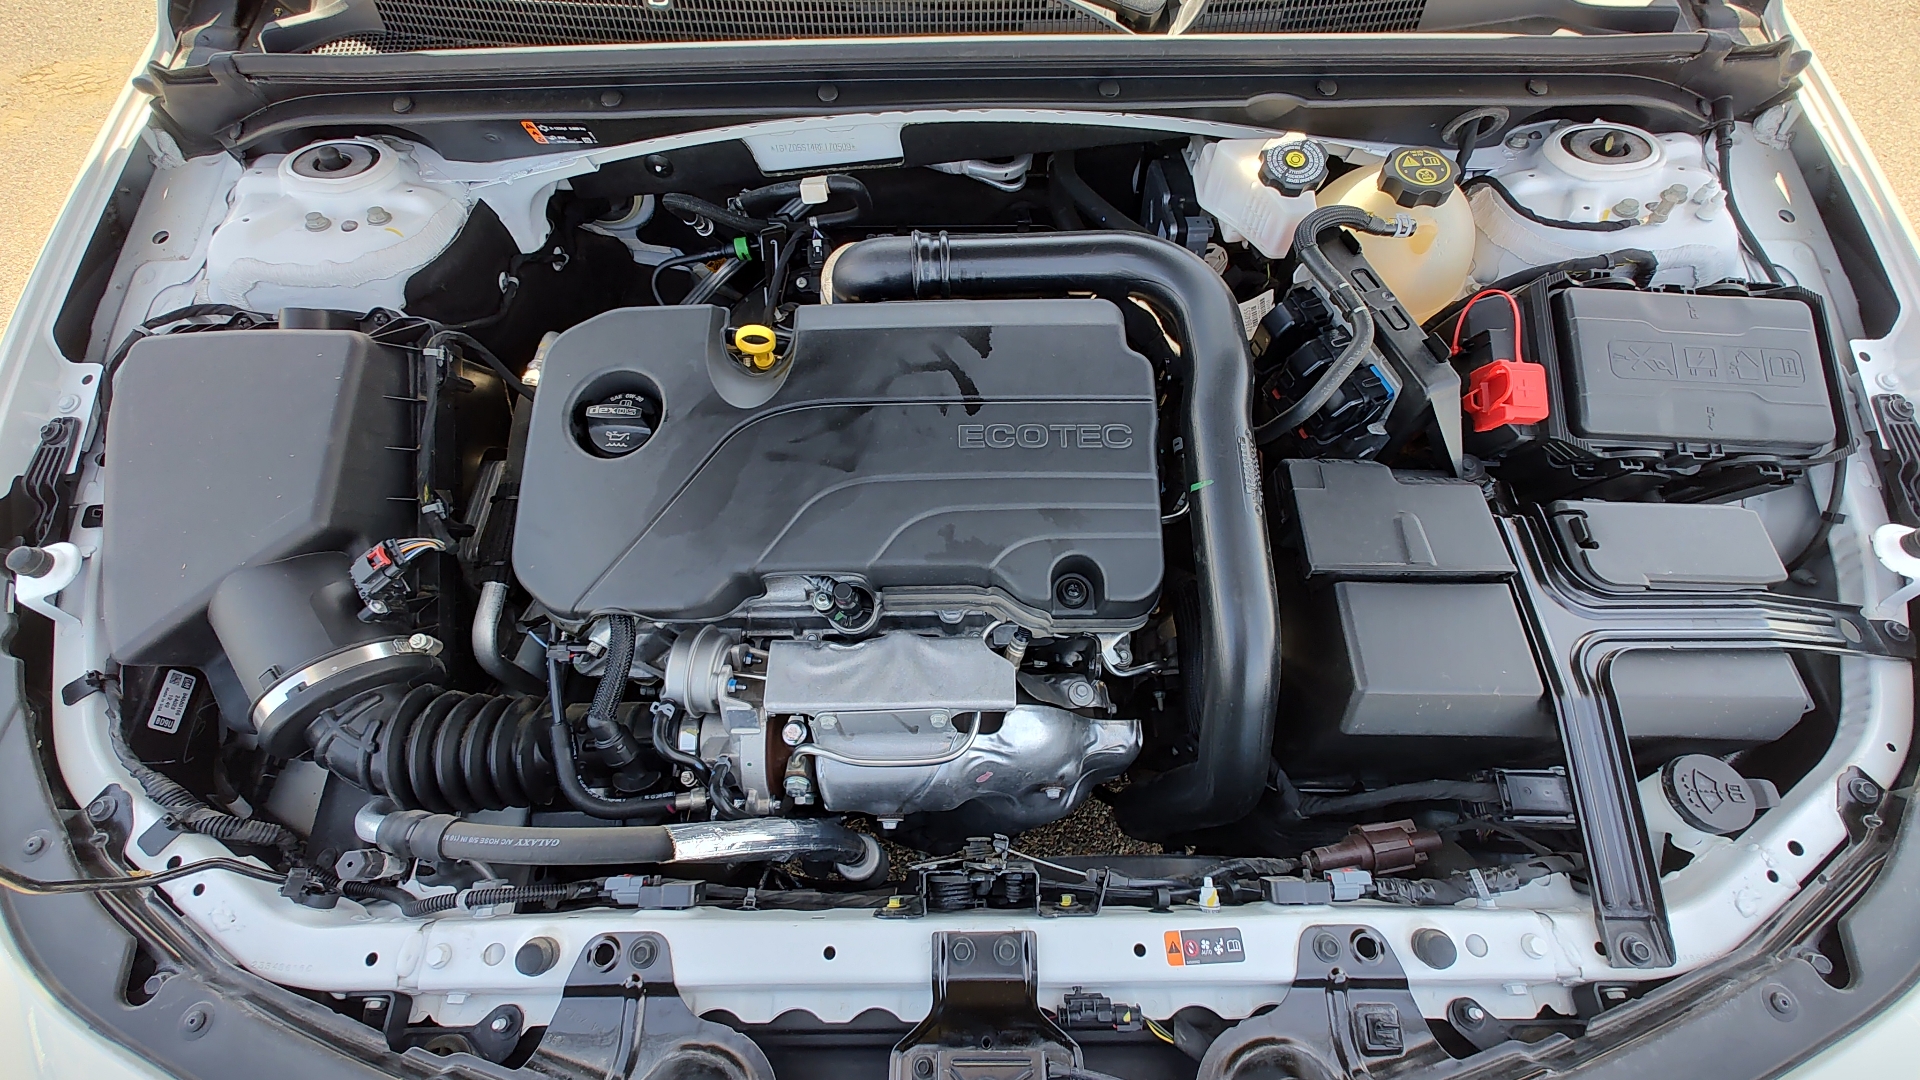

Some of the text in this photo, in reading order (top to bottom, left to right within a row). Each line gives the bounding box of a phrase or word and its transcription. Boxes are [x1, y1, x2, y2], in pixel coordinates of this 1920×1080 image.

[610, 394, 622, 402] SAE
[589, 405, 637, 416] dexos
[958, 424, 1133, 449] ECOTEC
[514, 838, 560, 847] GALAXY
